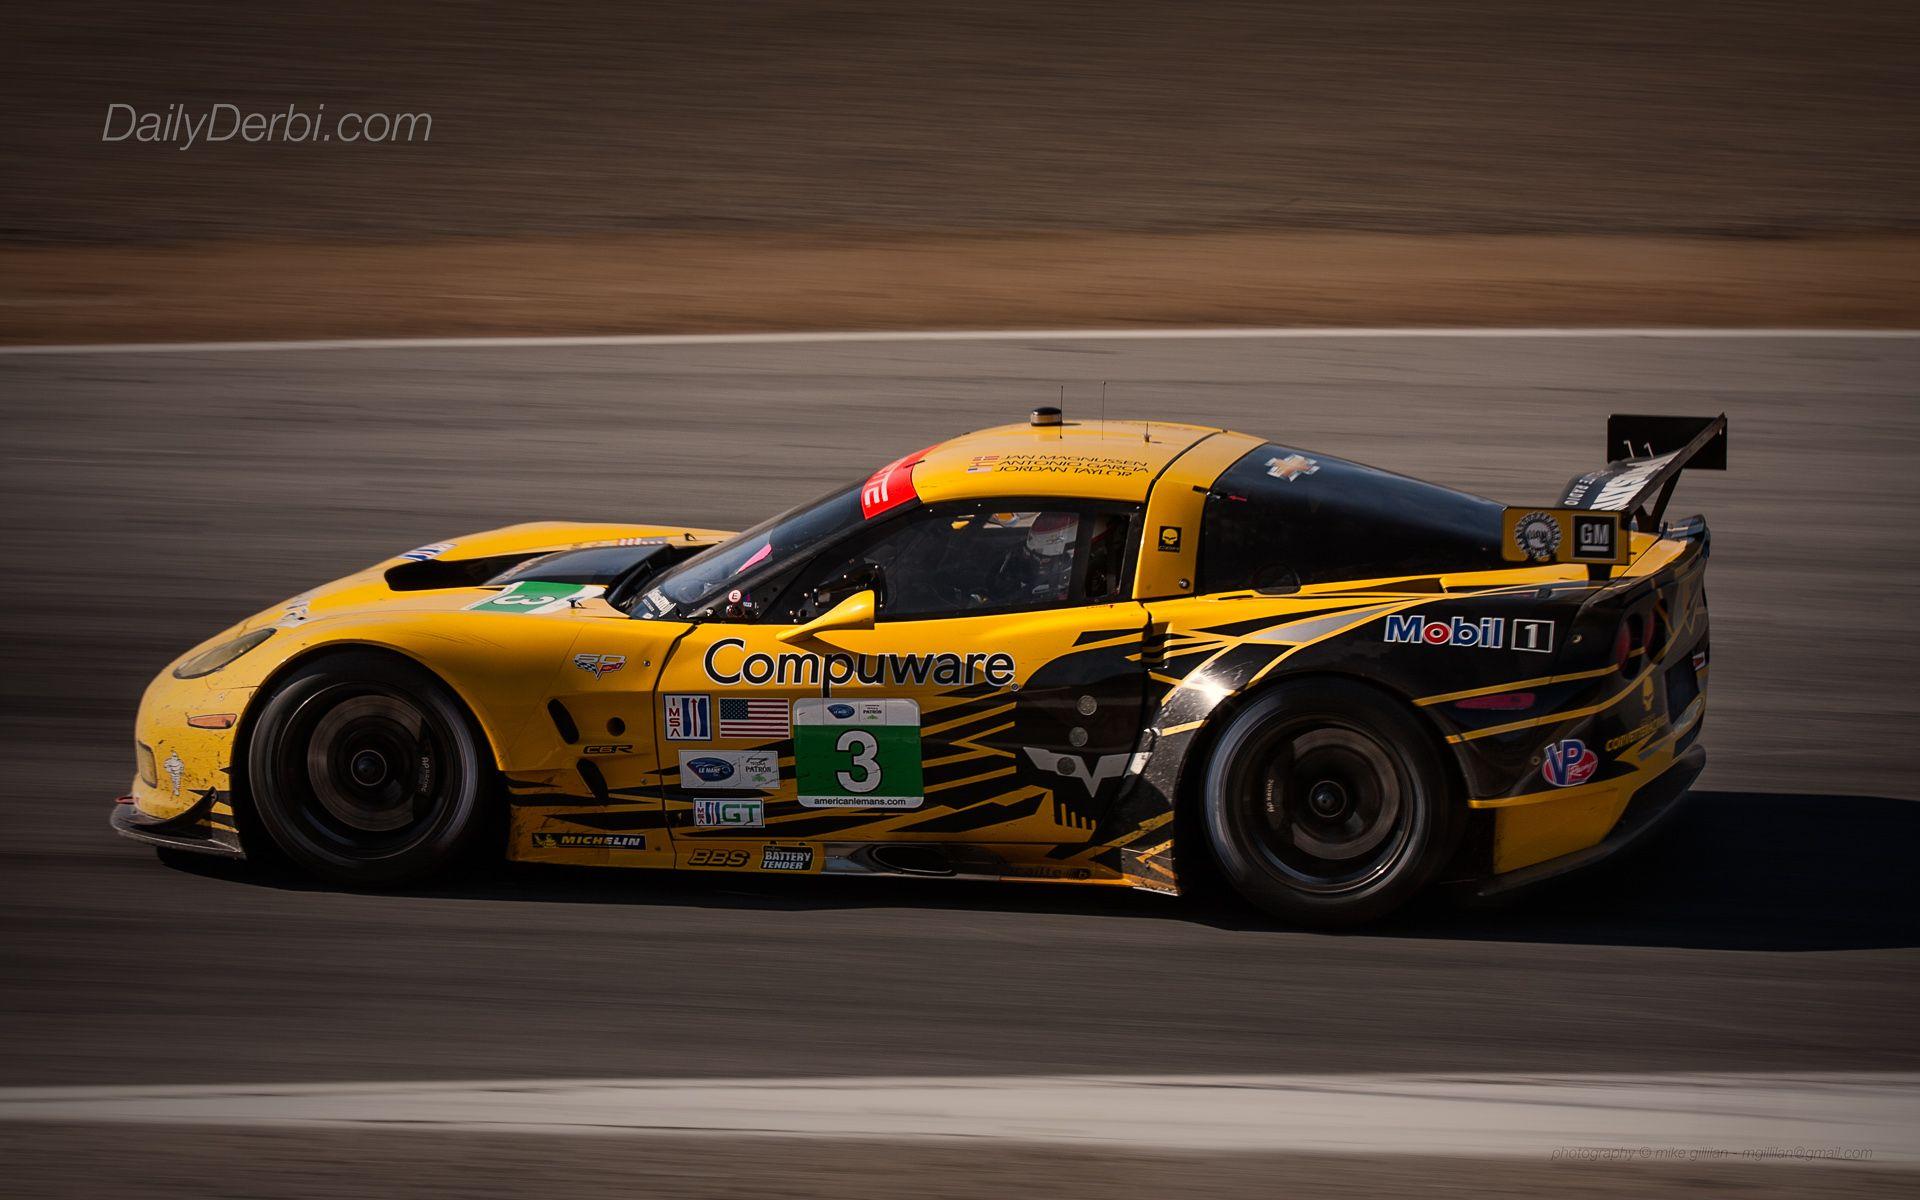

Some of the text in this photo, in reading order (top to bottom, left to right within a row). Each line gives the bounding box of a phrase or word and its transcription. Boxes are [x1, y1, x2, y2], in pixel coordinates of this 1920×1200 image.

[999, 460, 1082, 468] ANTONIO
[1580, 523, 1609, 545] GM
[1384, 615, 1505, 649] Mobil
[703, 638, 1015, 698] Compuware
[668, 697, 680, 737] IMSA
[835, 729, 883, 793] 3
[1544, 739, 1586, 786] VP
[814, 796, 906, 807] americanlemans.com
[721, 803, 760, 822] GT
[560, 836, 641, 847] MICHELIN
[688, 849, 750, 867] BBS
[762, 860, 804, 870] TENDER
[765, 851, 812, 862] BATTERY
